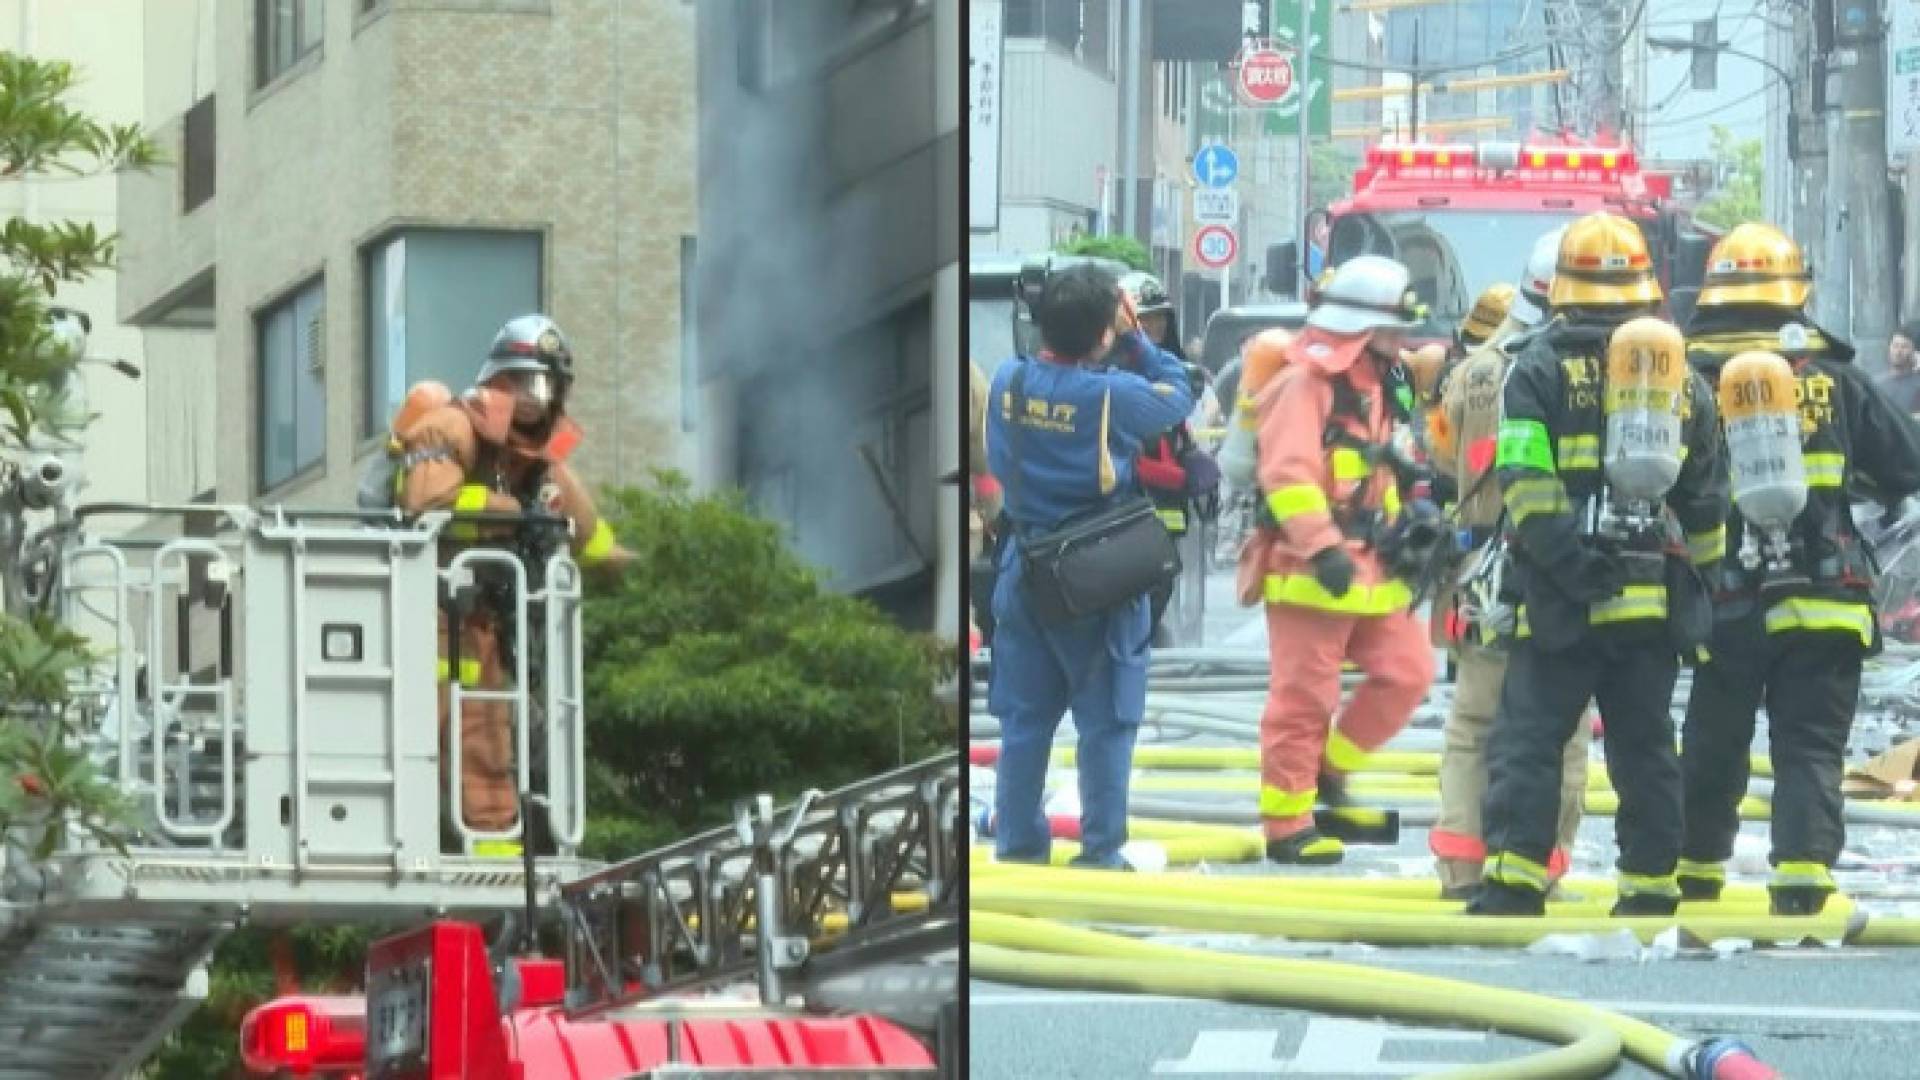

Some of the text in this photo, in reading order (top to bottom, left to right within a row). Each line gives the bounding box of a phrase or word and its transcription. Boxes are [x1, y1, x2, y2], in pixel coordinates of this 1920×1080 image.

[1246, 65, 1289, 85] 消火栓
[1204, 235, 1227, 256] 30
[1629, 348, 1669, 376] 300
[1733, 379, 1774, 408] 300
